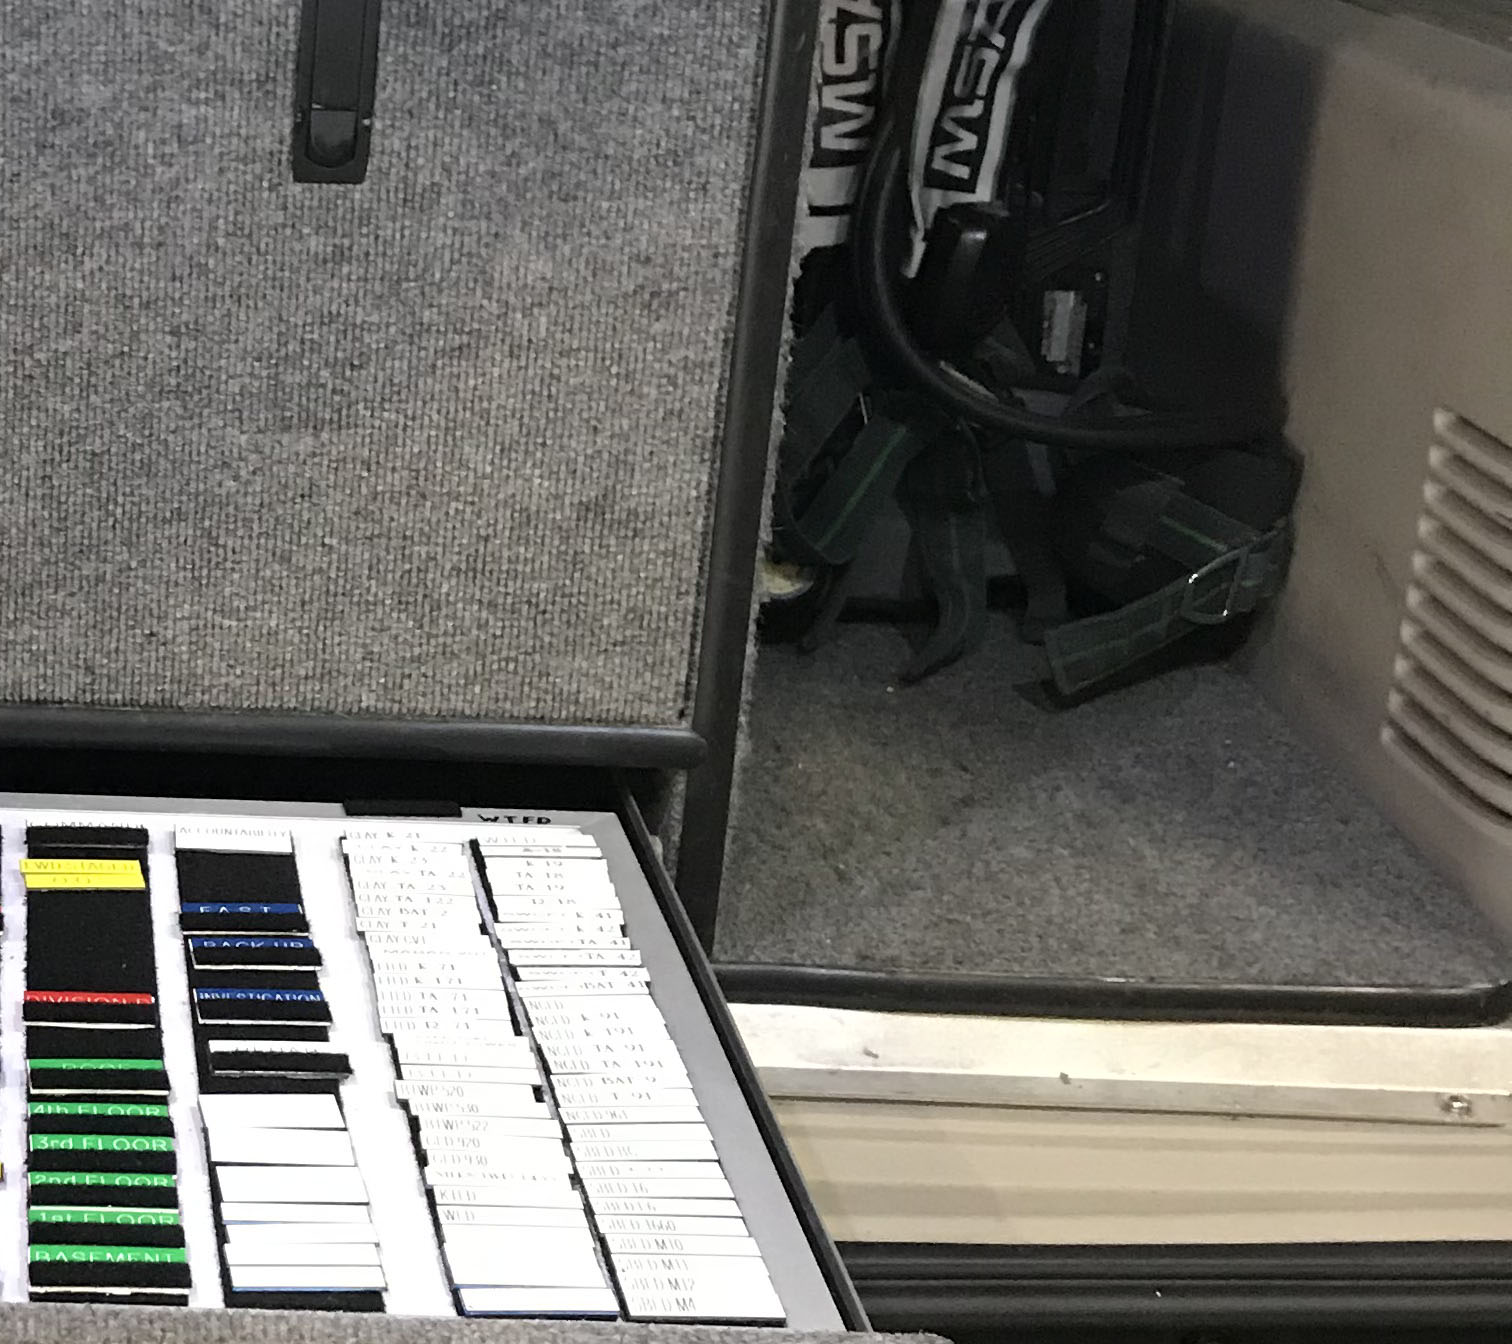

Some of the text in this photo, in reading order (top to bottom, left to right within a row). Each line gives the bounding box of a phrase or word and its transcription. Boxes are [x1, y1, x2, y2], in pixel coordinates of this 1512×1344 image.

[78, 1104, 162, 1117] FLOOR
[34, 1136, 169, 1151] 3rd FLOOR
